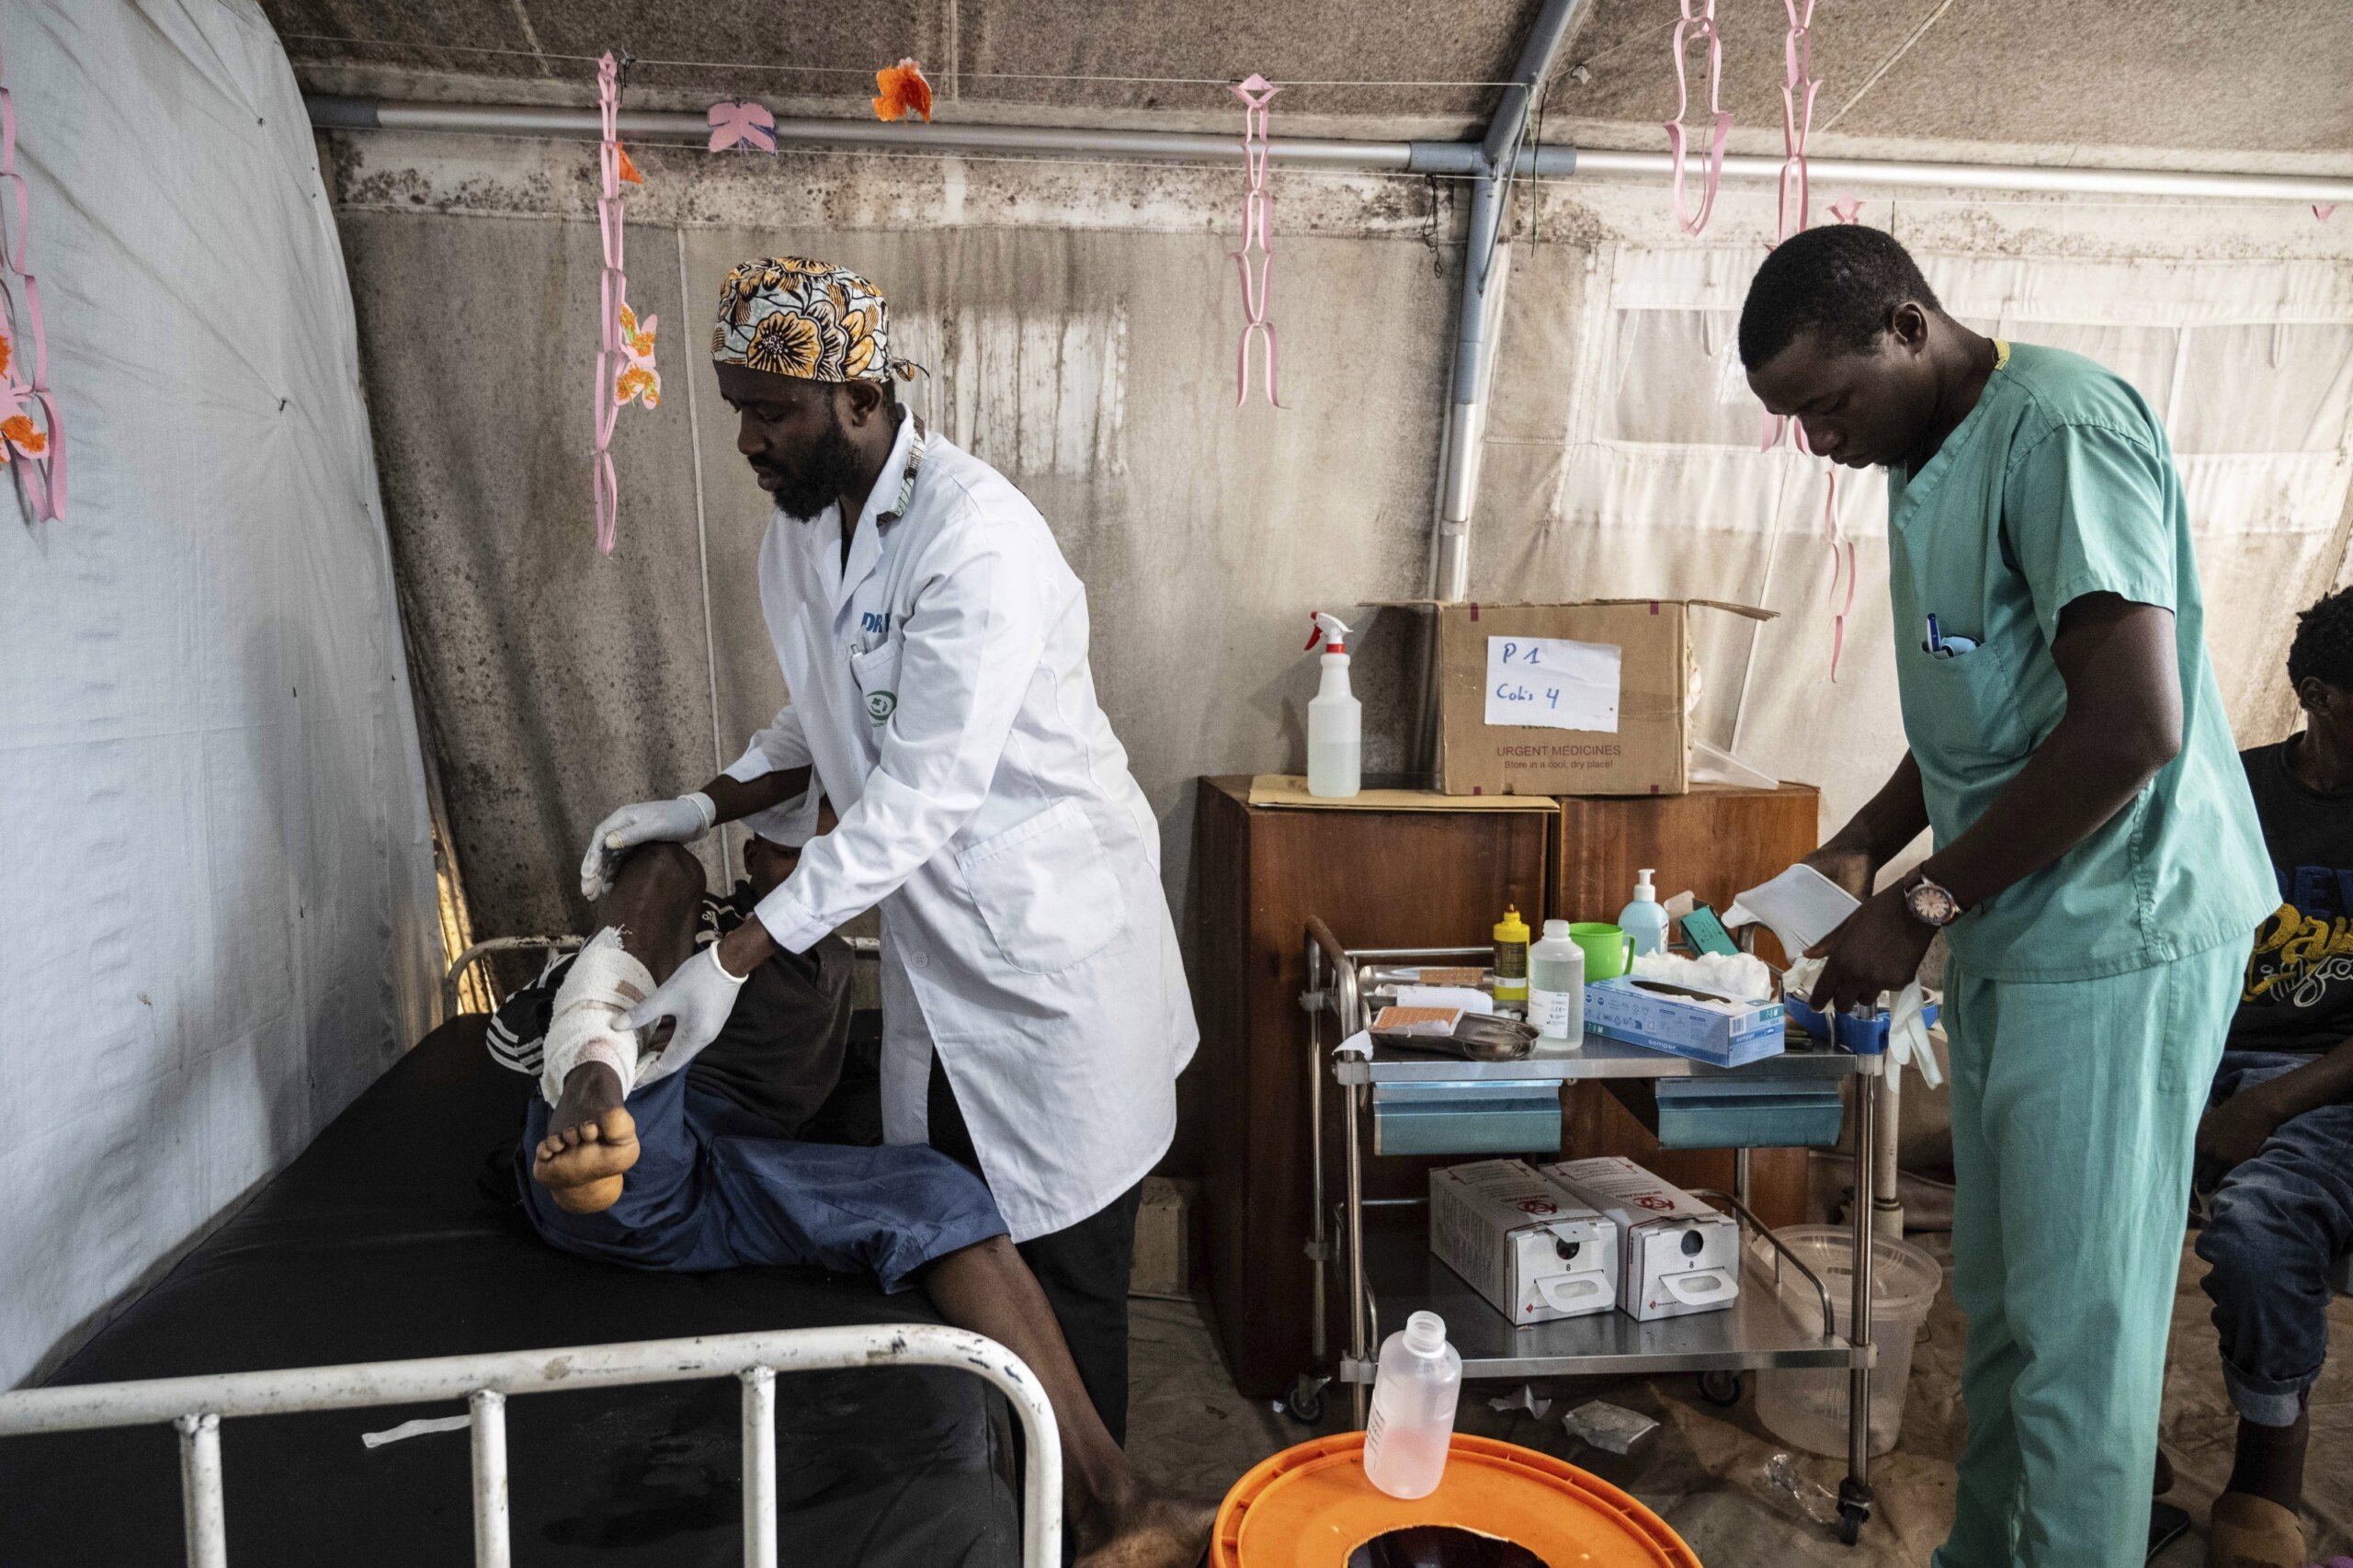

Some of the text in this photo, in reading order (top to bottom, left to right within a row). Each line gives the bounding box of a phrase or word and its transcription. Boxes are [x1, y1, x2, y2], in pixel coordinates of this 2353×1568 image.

[1503, 642, 1541, 664] P 1
[1546, 687, 1560, 709] 4
[1496, 744, 1621, 756] URGENT MEDICINES
[1504, 760, 1528, 769] Store
[1529, 760, 1538, 768] in
[1548, 760, 1568, 770] cool,
[1571, 760, 1584, 770] dry
[1647, 1039, 1677, 1051] semper
[1565, 1263, 1571, 1271] 8
[1689, 1260, 1694, 1268] 8
